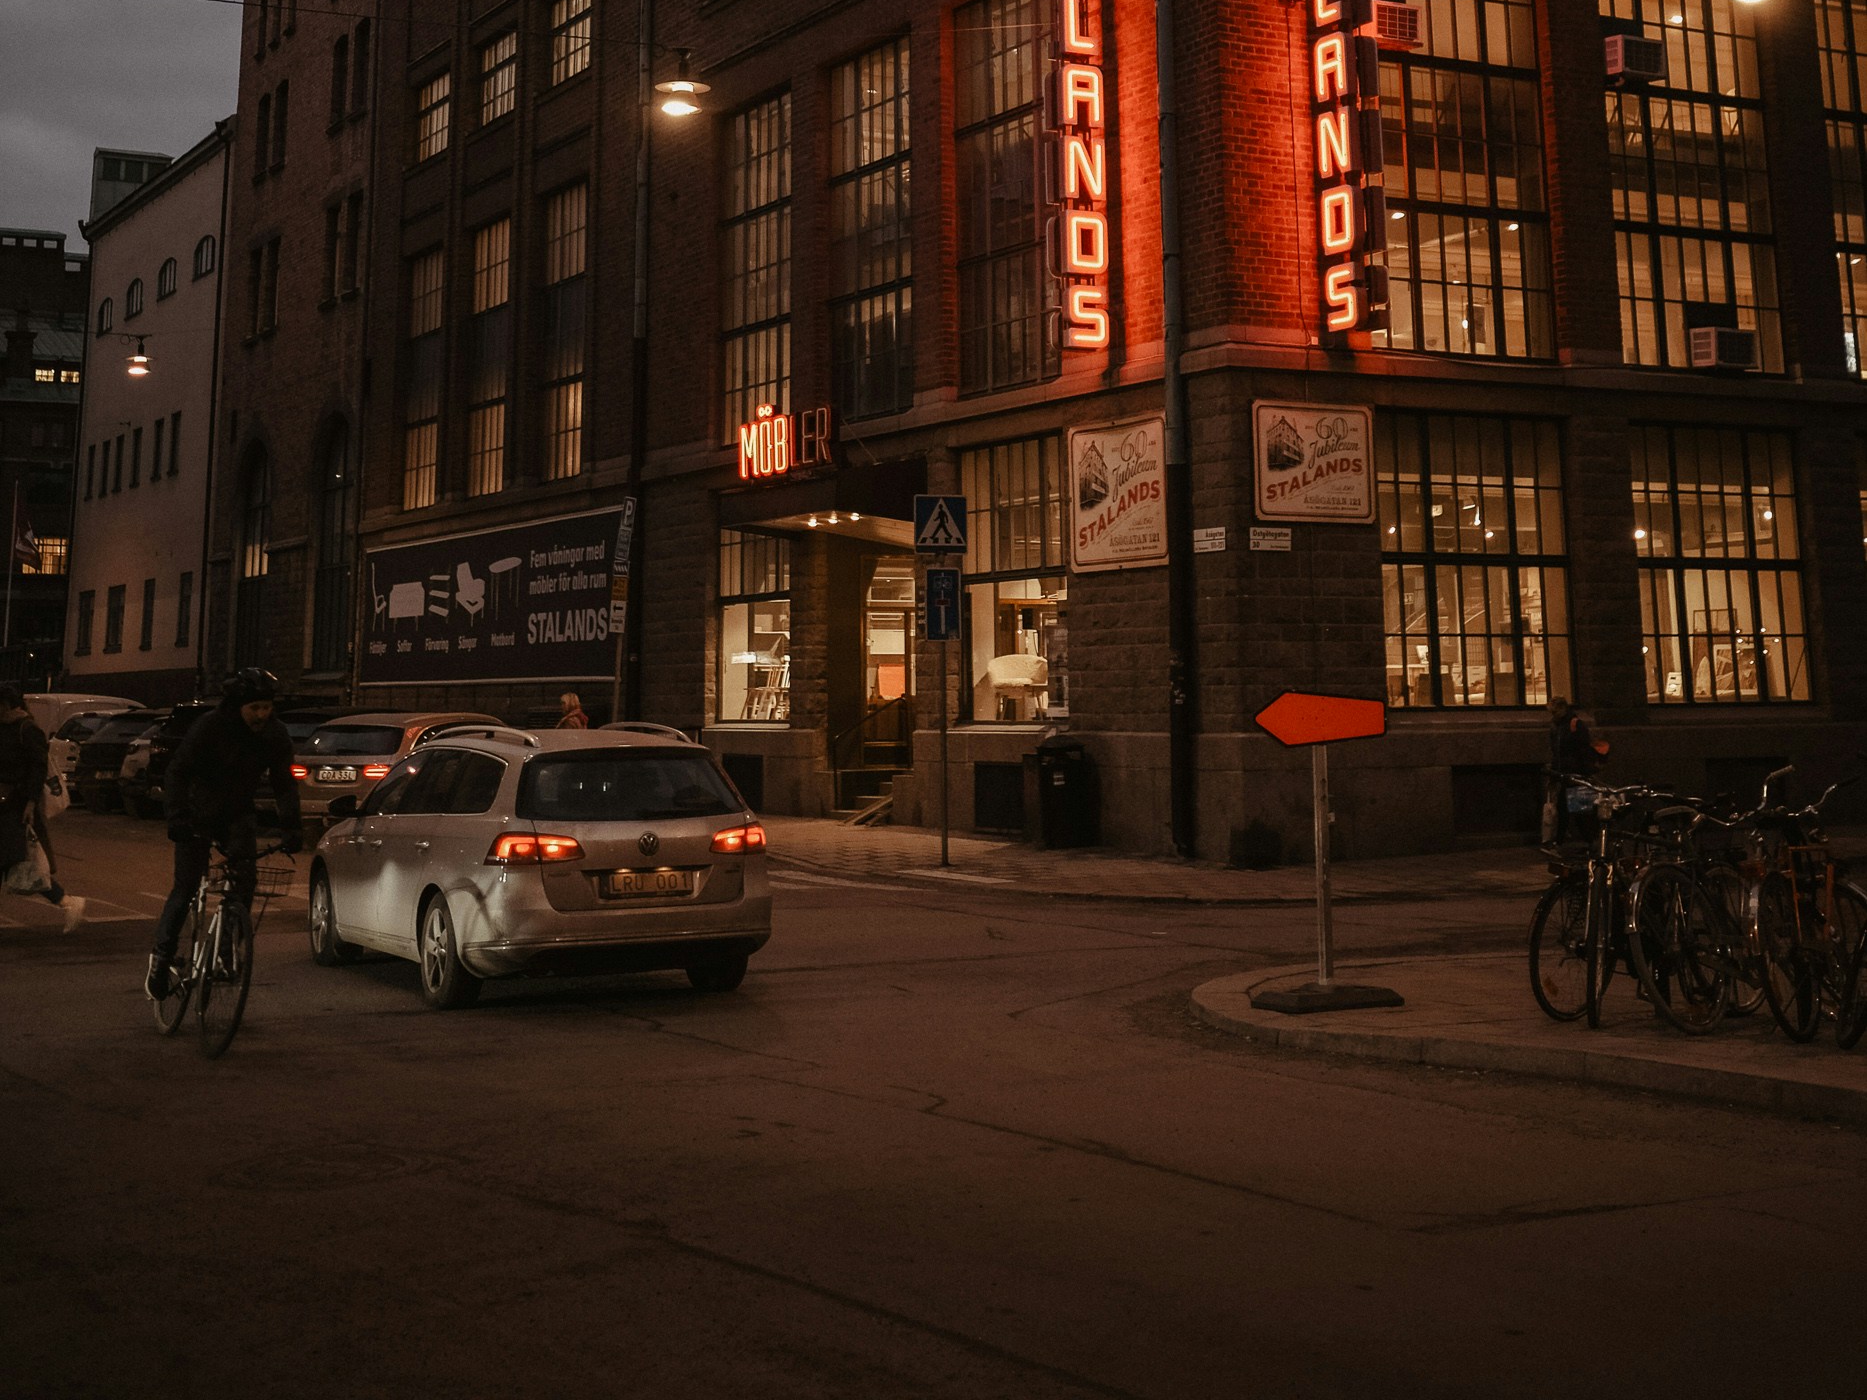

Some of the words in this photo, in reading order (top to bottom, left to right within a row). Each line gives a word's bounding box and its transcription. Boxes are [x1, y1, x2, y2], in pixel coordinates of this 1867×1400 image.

[738, 403, 833, 480] MÖBLER
[1315, 416, 1349, 440] 60
[1120, 430, 1148, 462] 60
[1308, 435, 1360, 469] Jubileum
[1112, 458, 1158, 503] Jubileum
[1266, 458, 1363, 500] STALANDS
[623, 500, 634, 525] P
[1079, 479, 1161, 548] STALANDS
[1349, 498, 1362, 506] 121
[1149, 532, 1160, 543] 121
[530, 549, 547, 568] Fem
[548, 544, 585, 568] våningar
[586, 539, 606, 561] med
[529, 574, 557, 595] möbler
[559, 572, 570, 591] för
[572, 570, 588, 590] alla
[589, 572, 607, 588] rum
[527, 607, 608, 645] STALANDS
[611, 875, 644, 892] LRU
[656, 872, 688, 890] 001
